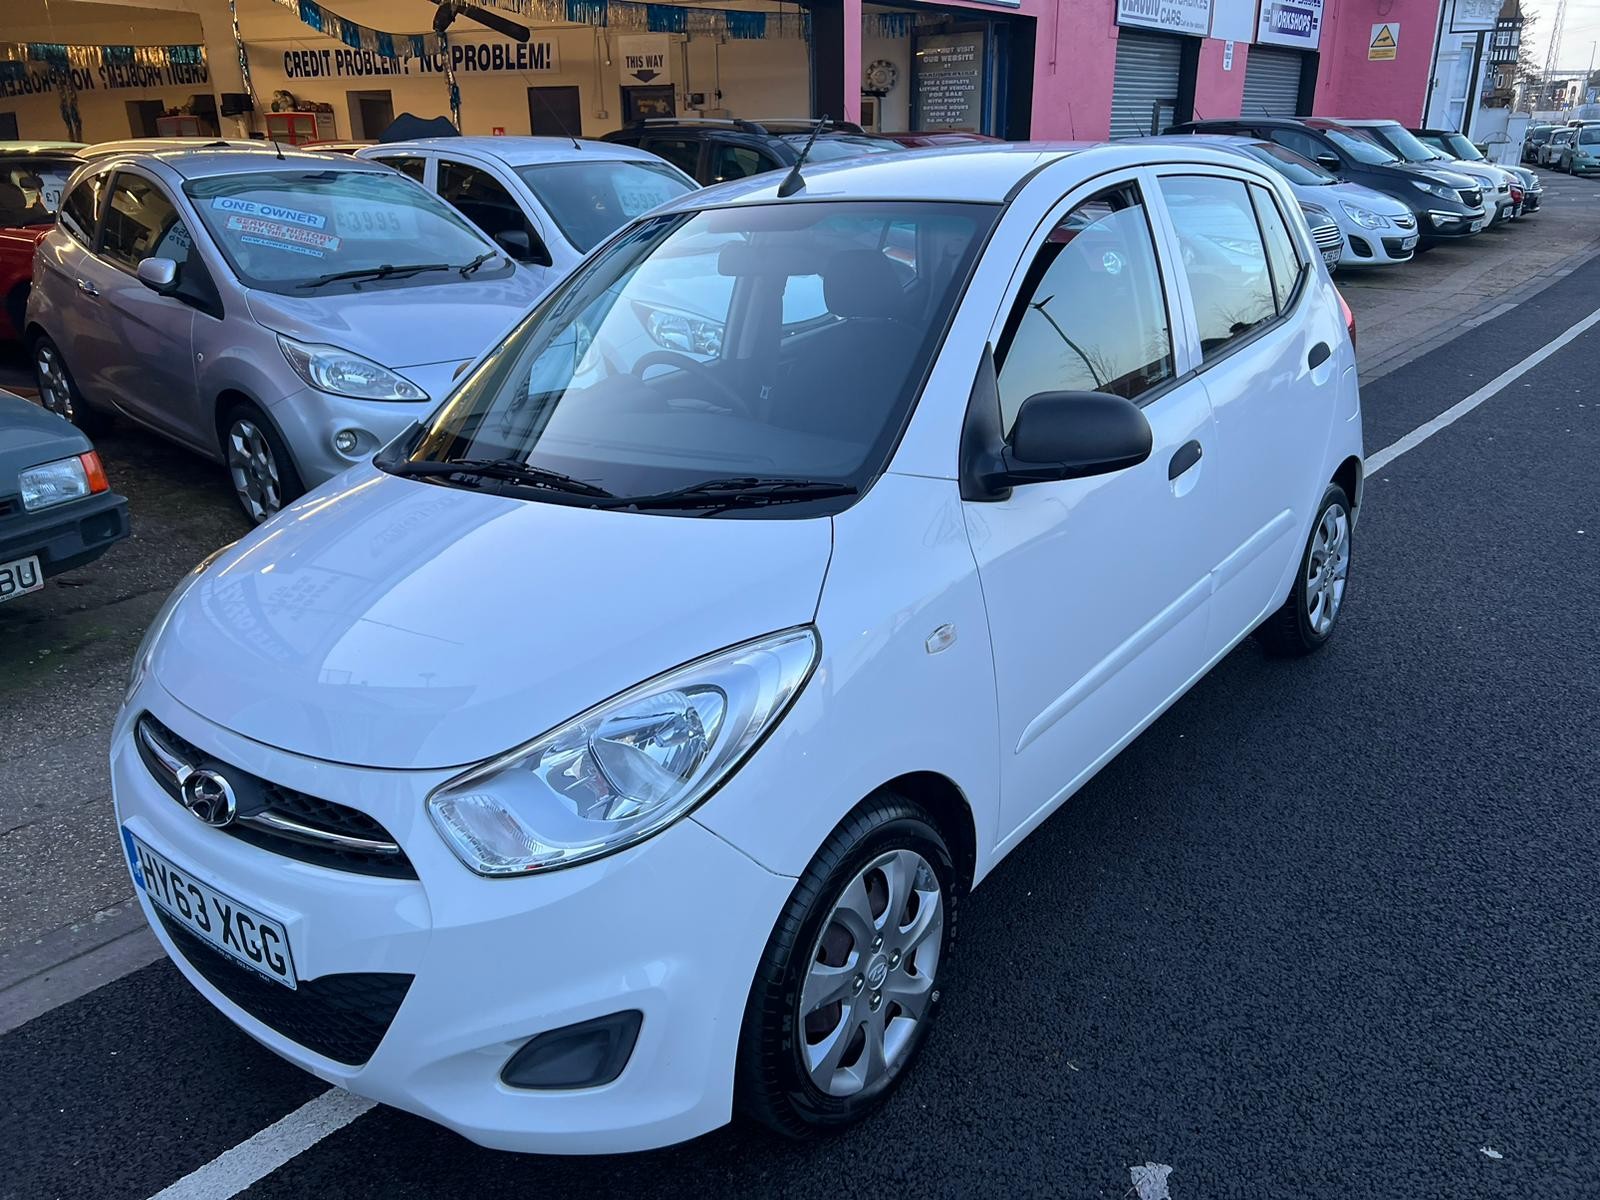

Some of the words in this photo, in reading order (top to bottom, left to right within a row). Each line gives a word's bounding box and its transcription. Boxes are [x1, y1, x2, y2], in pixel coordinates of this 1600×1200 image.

[1161, 8, 1181, 26] CARS
[1271, 10, 1311, 32] WORKSHOPS
[284, 50, 331, 78] CREDIT
[420, 52, 445, 73] NO
[452, 42, 551, 72] PROBLEM!
[626, 55, 643, 68] THIS
[645, 54, 664, 68] WAY
[941, 54, 975, 62] WEBSITE
[221, 200, 256, 212] ONE
[261, 206, 318, 225] OWNER
[336, 211, 401, 232] £3995
[236, 217, 283, 230] SERVICE
[286, 228, 334, 242] HISTORY
[241, 224, 265, 233] WITH
[267, 229, 286, 238] THIS
[288, 234, 324, 245] VEHICLE
[261, 240, 290, 249] LOWER
[137, 846, 211, 933] HY63
[213, 897, 287, 976] XGG
